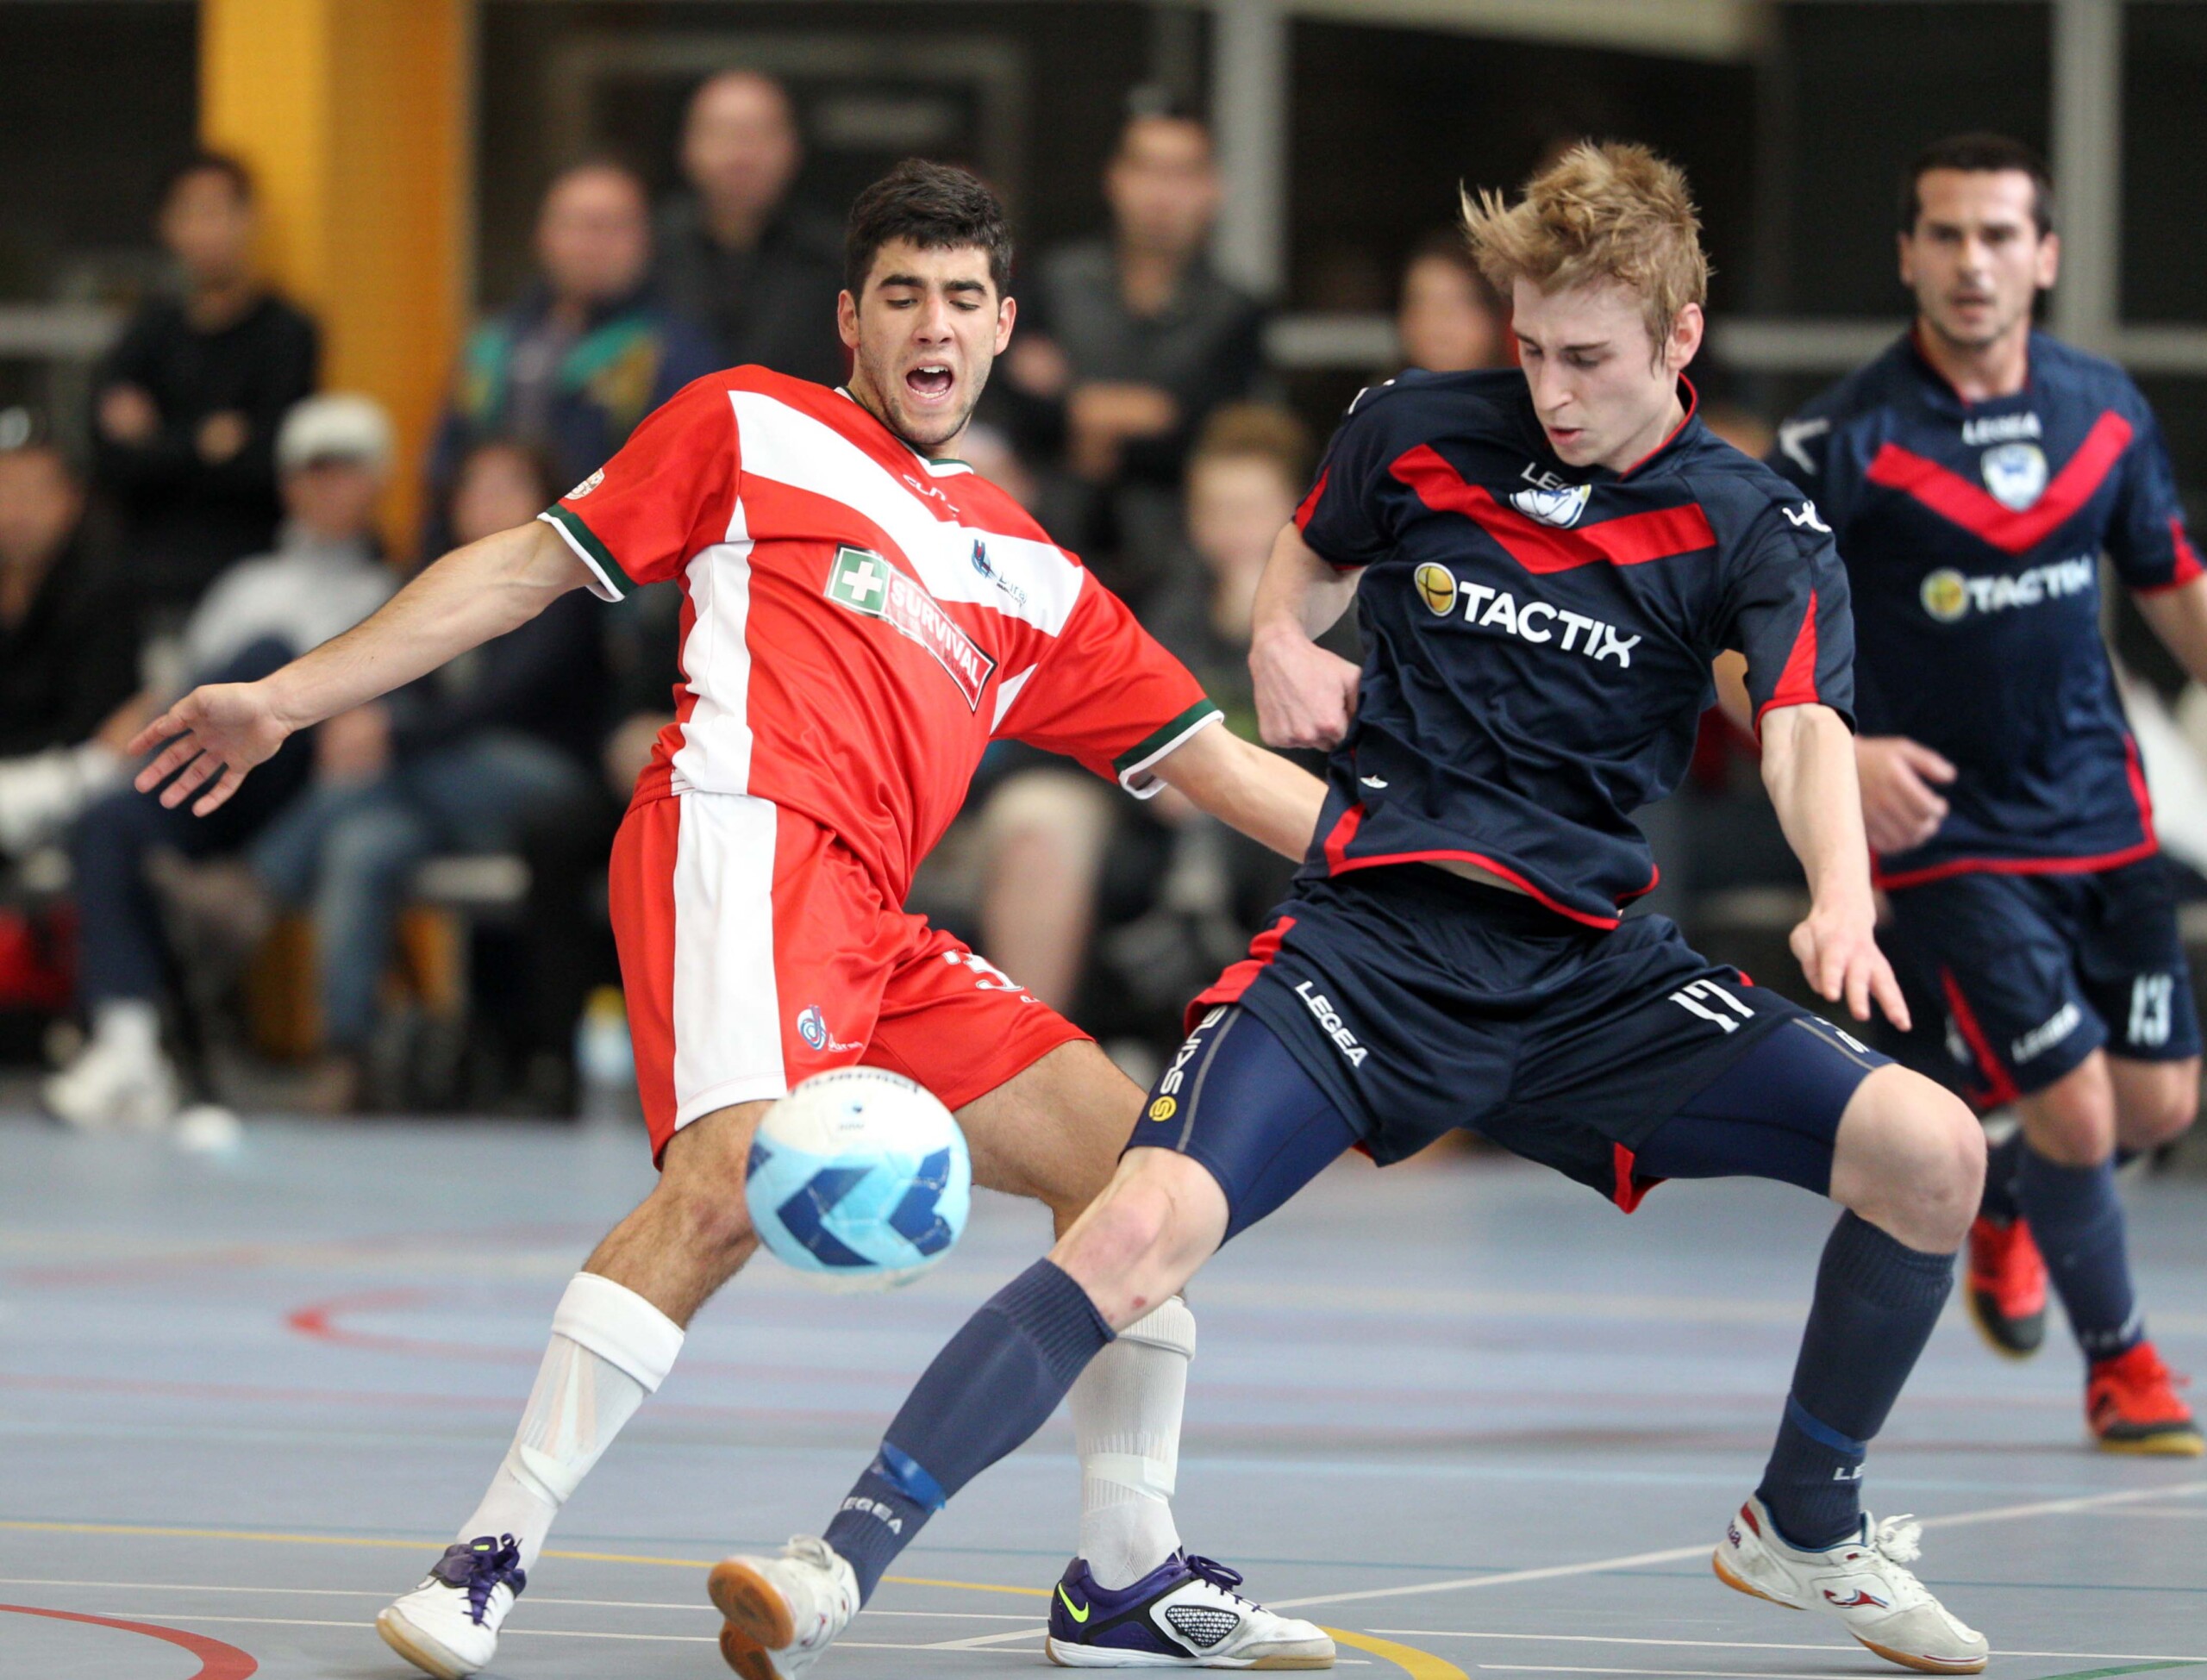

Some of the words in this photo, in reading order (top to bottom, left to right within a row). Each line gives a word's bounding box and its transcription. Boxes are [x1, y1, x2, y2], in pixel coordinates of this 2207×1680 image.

[890, 578, 979, 688] SURVIVAL
[1459, 579, 1641, 669] TACTIX
[1294, 980, 1369, 1068] LEGEA
[1667, 978, 1755, 1034] 17
[841, 1496, 903, 1534] EGEA
